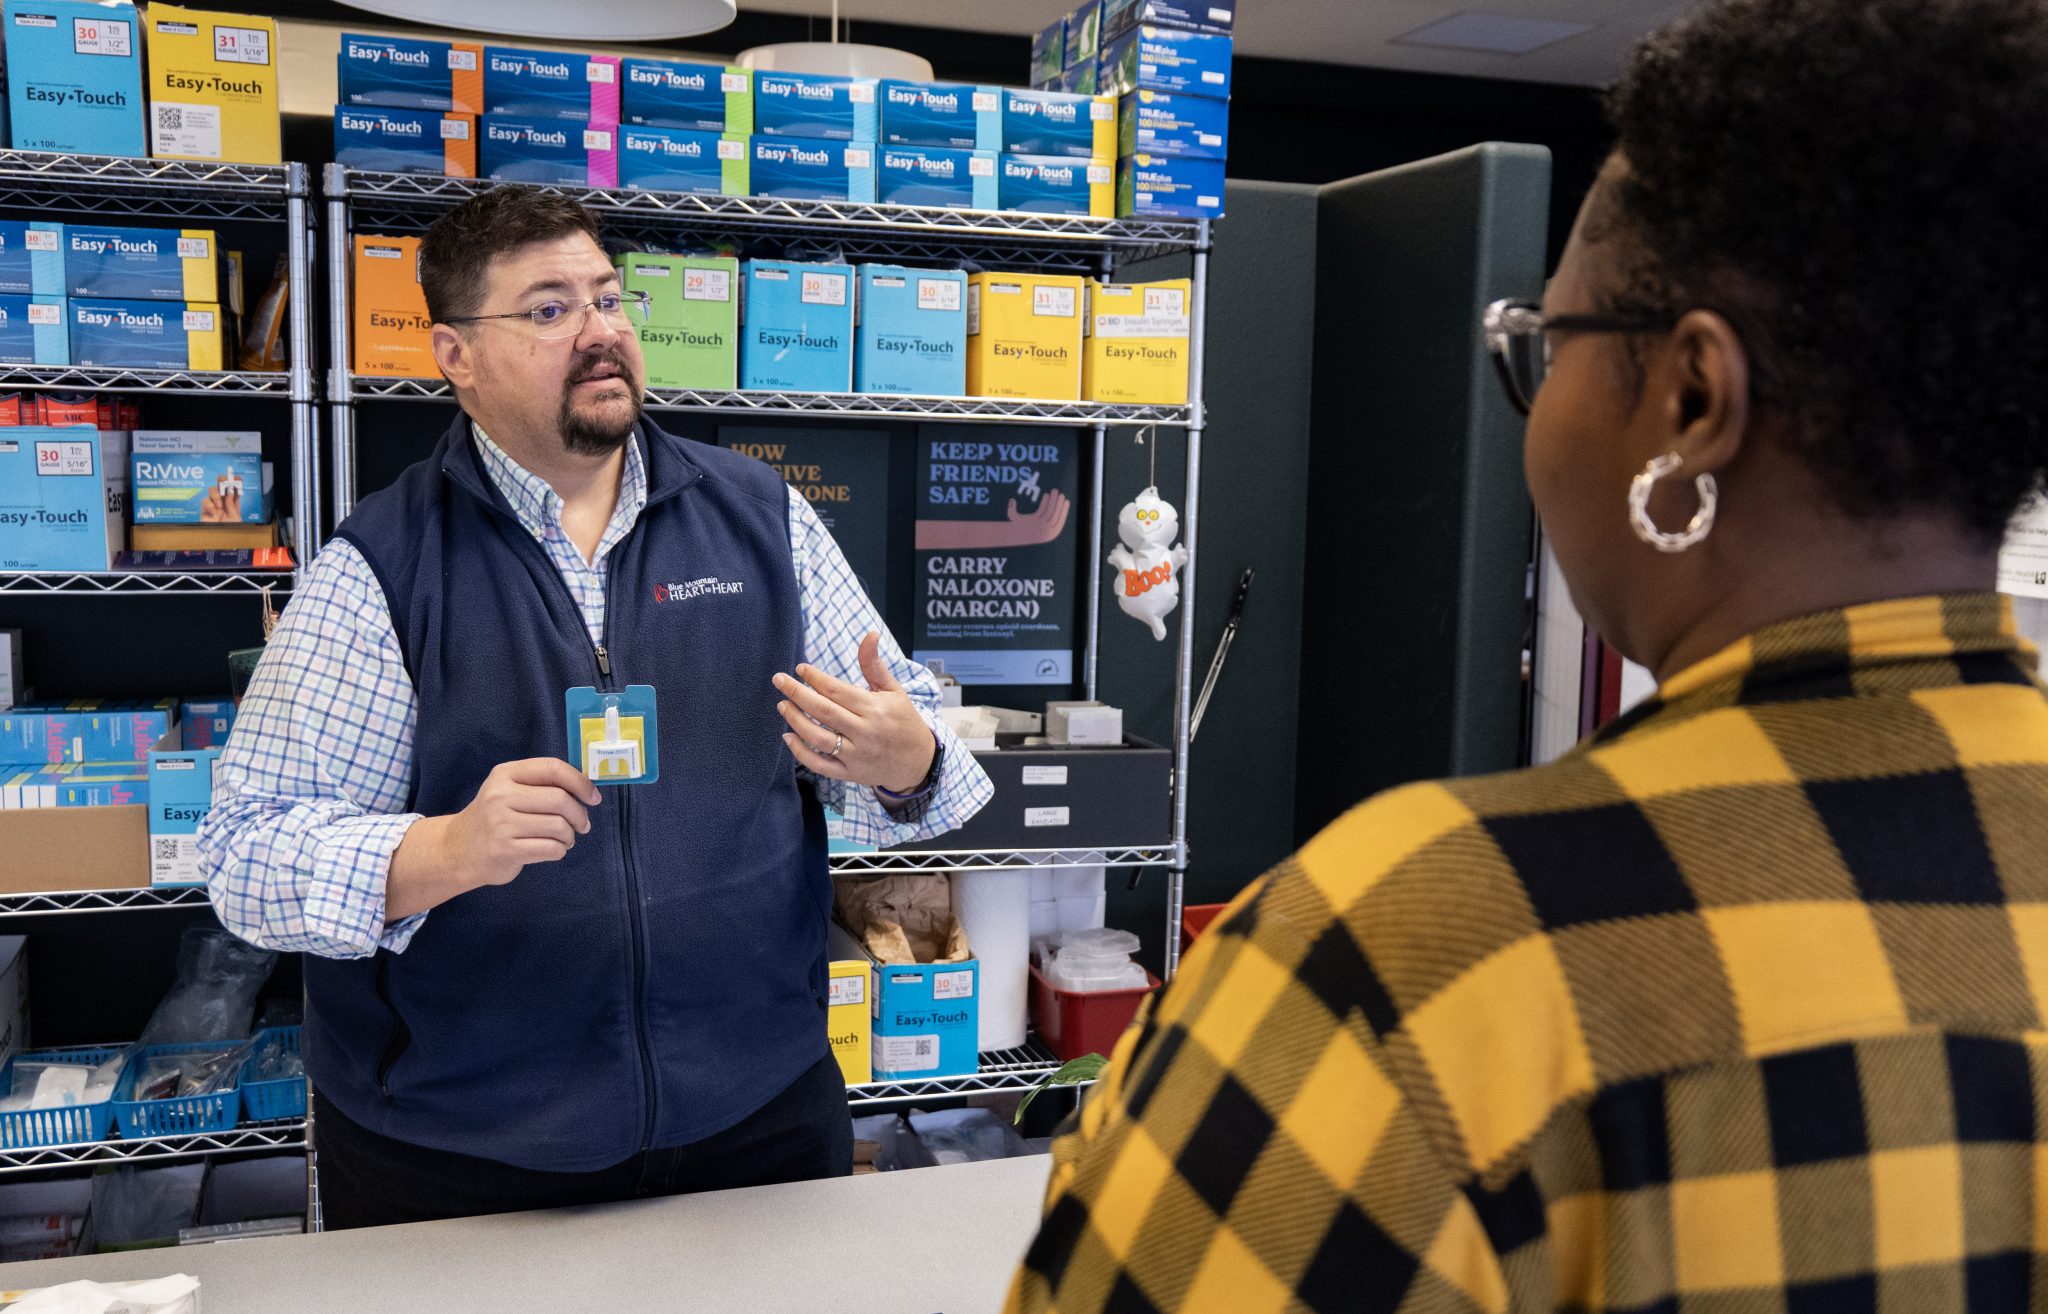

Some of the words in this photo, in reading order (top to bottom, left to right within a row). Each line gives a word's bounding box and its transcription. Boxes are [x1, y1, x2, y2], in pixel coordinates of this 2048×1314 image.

[78, 27, 97, 39] 30
[220, 36, 236, 47] 31
[688, 276, 702, 287] 29
[804, 280, 820, 291] 30
[921, 287, 936, 296] 30
[1037, 293, 1050, 304] 31
[1148, 295, 1160, 305] 31
[1108, 318, 1120, 326] BD
[40, 450, 58, 462] 30
[930, 442, 993, 461] KEEP
[996, 444, 1060, 462] YOUR
[930, 464, 1032, 484] FRIENDS
[929, 486, 990, 504] SAFE
[928, 556, 1008, 574] CARRY
[668, 583, 684, 591] Blue
[685, 576, 718, 588] Mountain
[1123, 561, 1171, 597] BOO!
[670, 584, 705, 600] HEART
[712, 582, 744, 594] HEART
[928, 578, 1054, 596] NALOXONE
[926, 600, 1040, 620] (NARCAN)
[936, 980, 950, 988] 30
